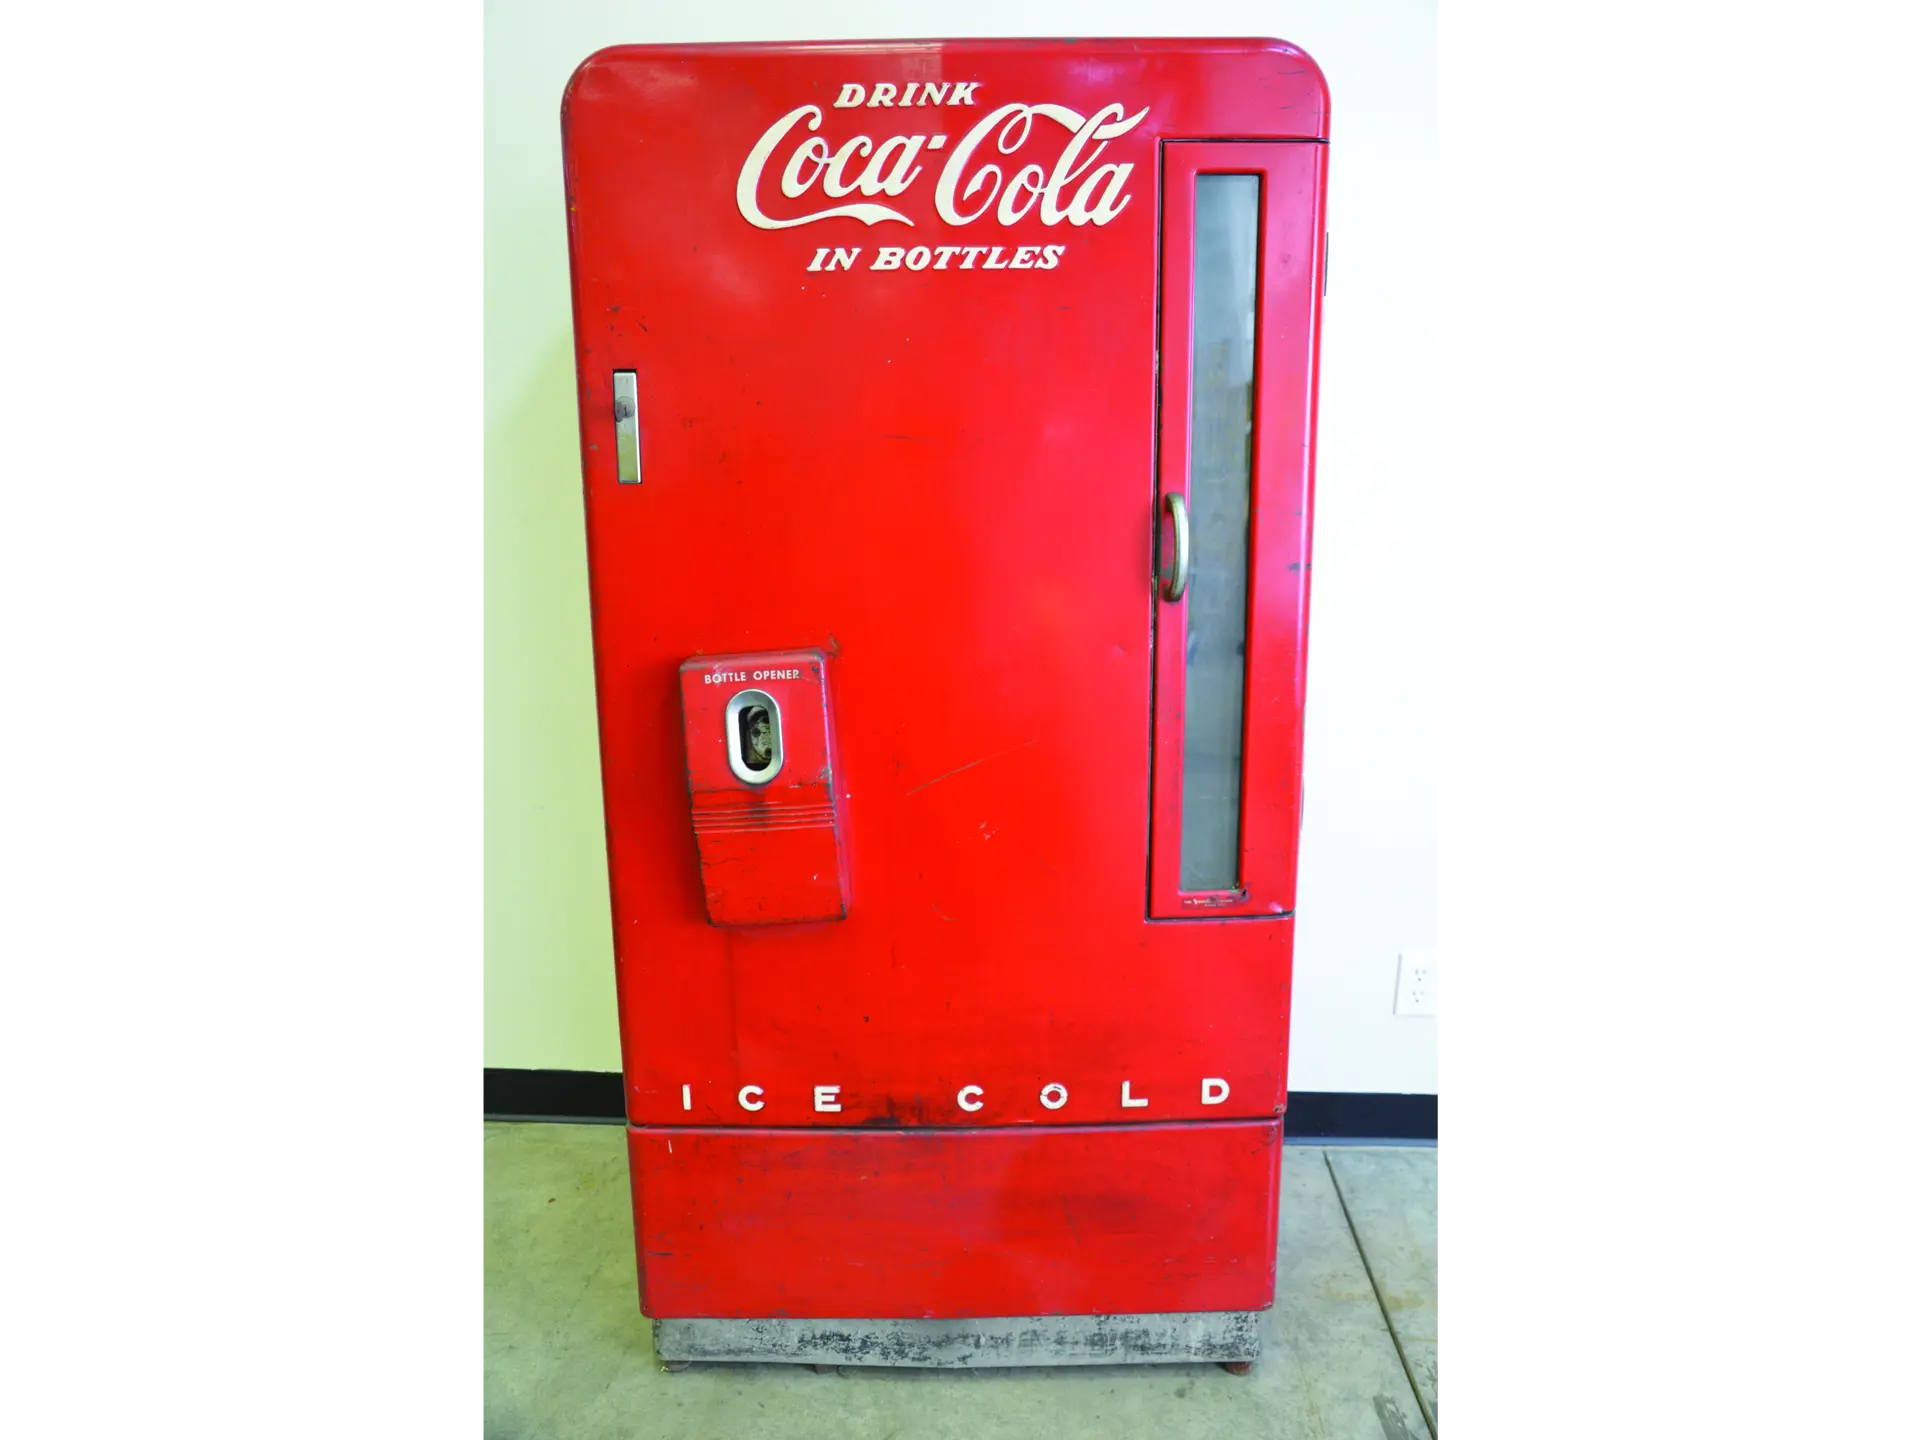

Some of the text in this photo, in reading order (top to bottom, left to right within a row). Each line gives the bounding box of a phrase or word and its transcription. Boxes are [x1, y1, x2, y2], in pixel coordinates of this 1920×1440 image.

[833, 82, 981, 108] DRINK
[736, 102, 1150, 230] Coca-Cola
[806, 244, 1066, 272] IN BOTTLES
[704, 669, 801, 684] BOTTLE OPENER
[681, 1077, 1231, 1113] ICE COLD
